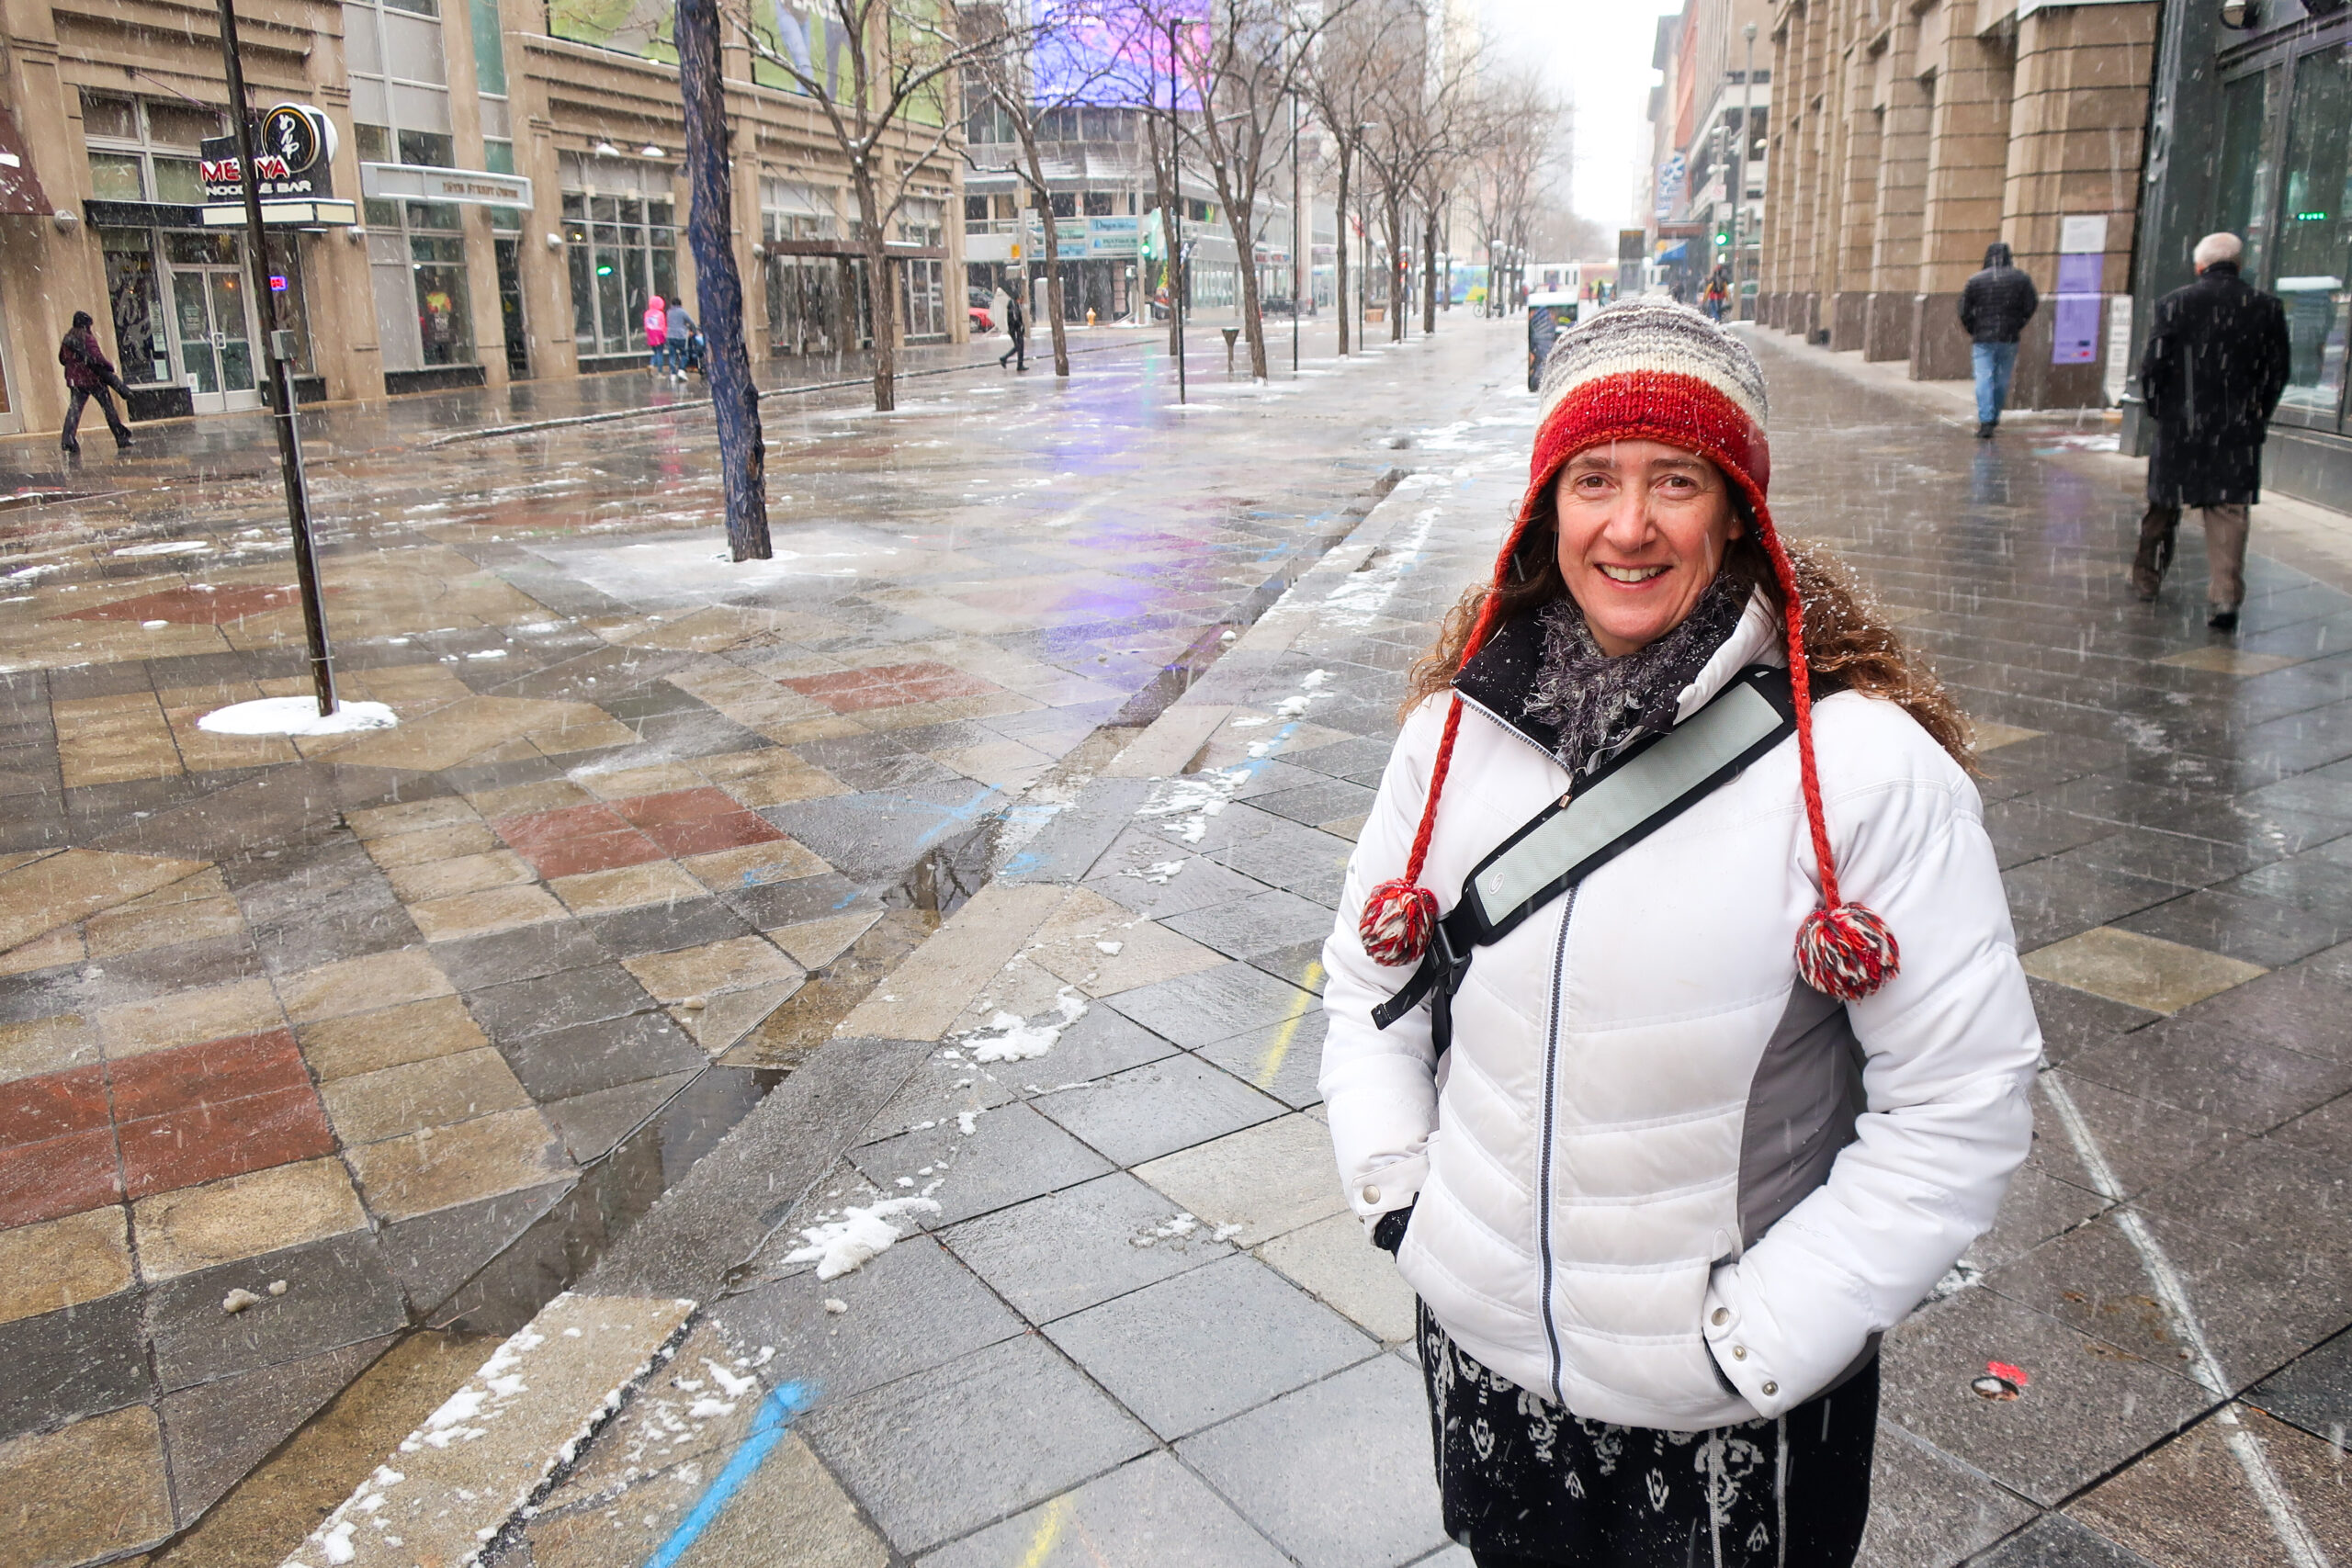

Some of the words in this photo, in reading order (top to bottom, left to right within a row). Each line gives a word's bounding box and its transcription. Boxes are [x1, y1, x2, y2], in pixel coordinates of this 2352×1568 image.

[200, 154, 290, 182] MEYA
[205, 182, 274, 196] NOOE
[277, 180, 311, 193] BAR
